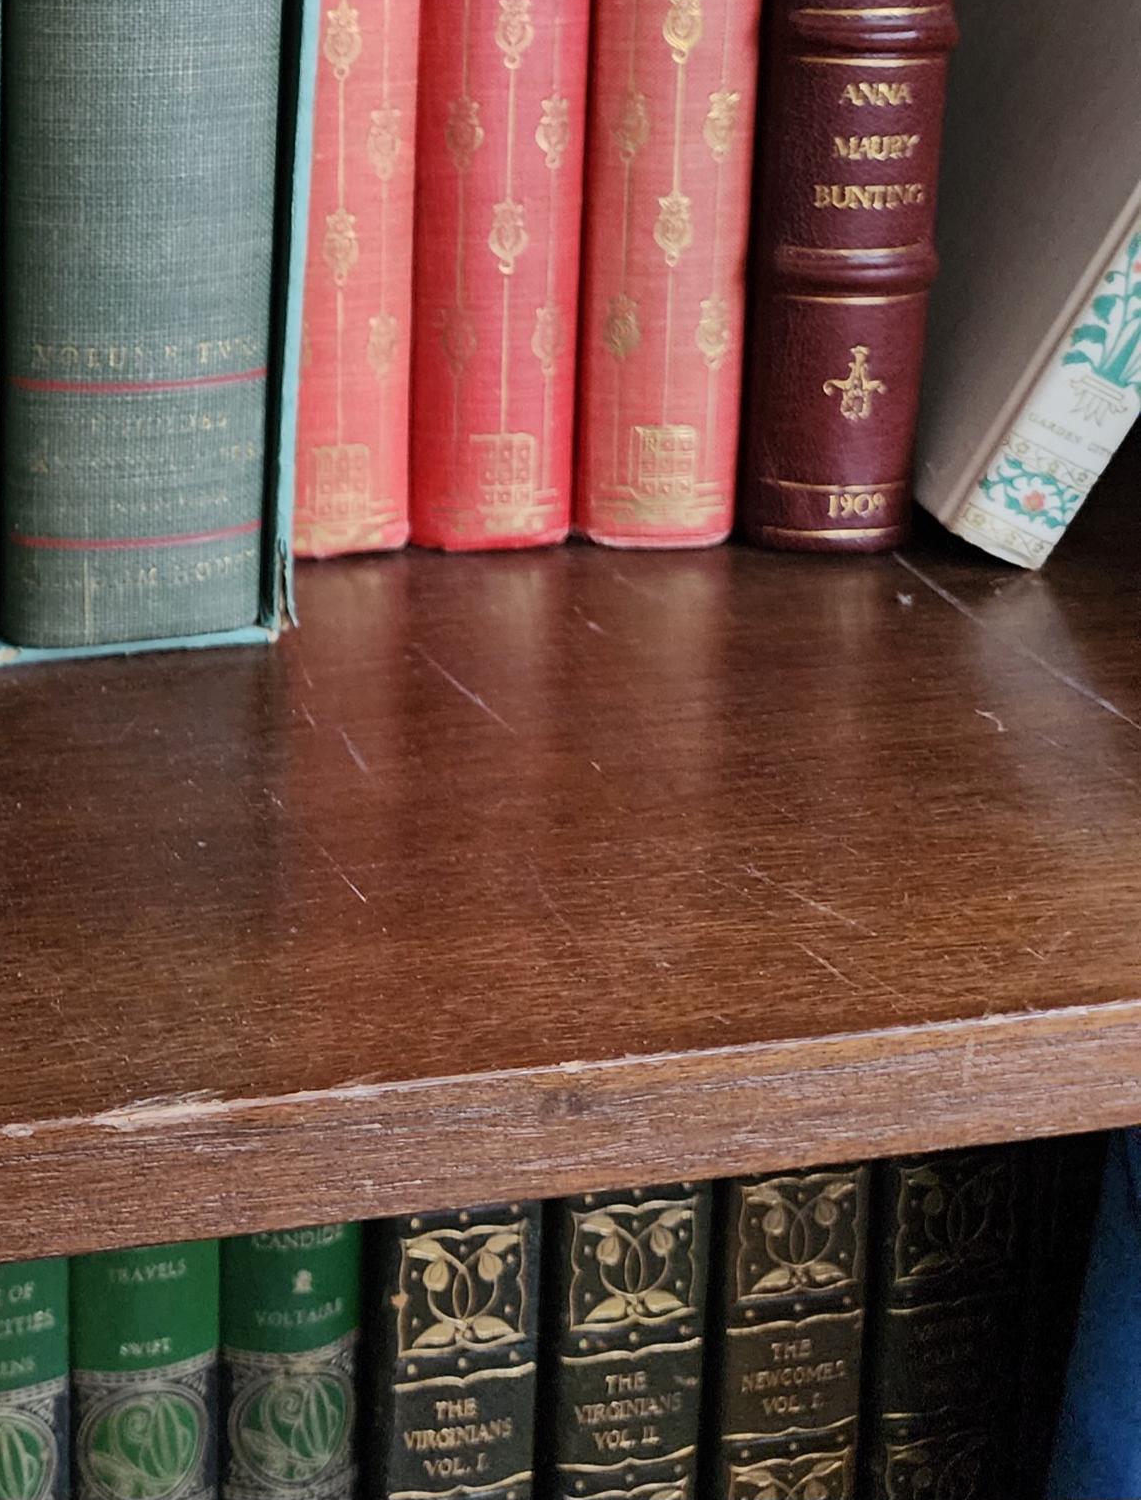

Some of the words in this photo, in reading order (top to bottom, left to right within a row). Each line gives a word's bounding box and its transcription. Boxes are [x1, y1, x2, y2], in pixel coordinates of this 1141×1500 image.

[839, 81, 914, 107] ANNA
[833, 134, 922, 160] MAURY
[813, 183, 924, 211] BUNTING
[826, 490, 887, 520] 1909
[119, 1336, 173, 1358] SWIFT
[770, 1337, 813, 1362] THE
[604, 1370, 650, 1395] THE
[434, 1396, 480, 1421] THE
[573, 1390, 684, 1425] VIRGINIANS
[402, 1416, 514, 1451] VIRGINIANS
